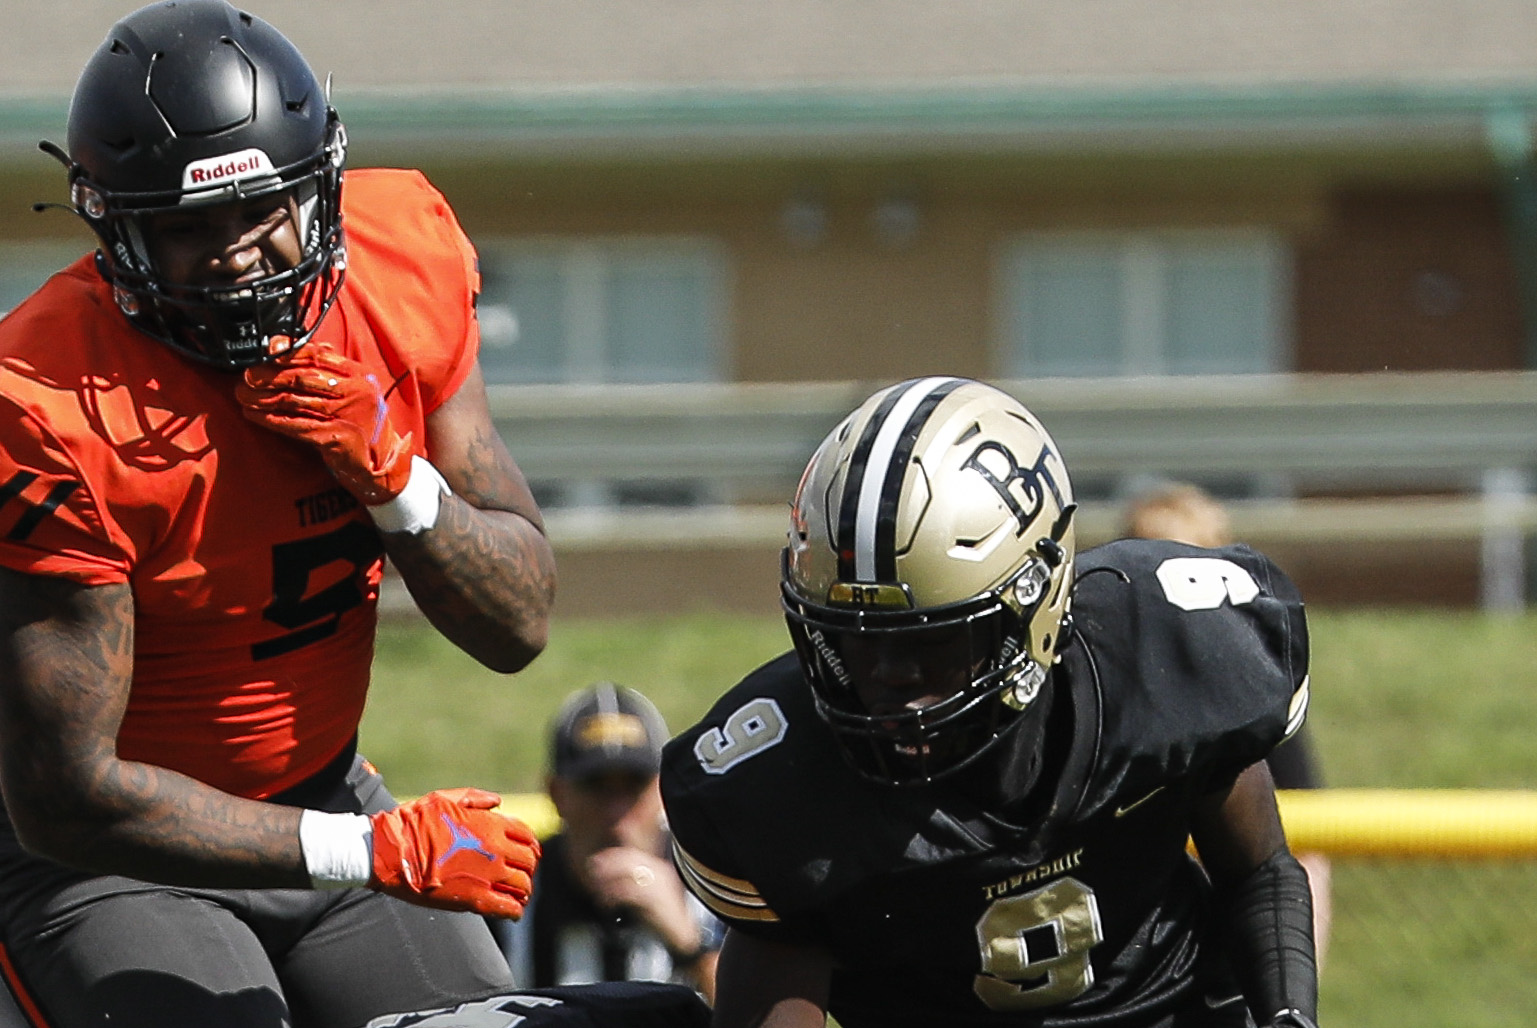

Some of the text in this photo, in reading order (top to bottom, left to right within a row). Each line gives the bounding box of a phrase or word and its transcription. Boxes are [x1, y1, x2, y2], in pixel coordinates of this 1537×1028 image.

[190, 156, 260, 184] Riddell
[1155, 556, 1261, 612] 9
[693, 696, 790, 776] 9
[973, 876, 1105, 1012] 9
